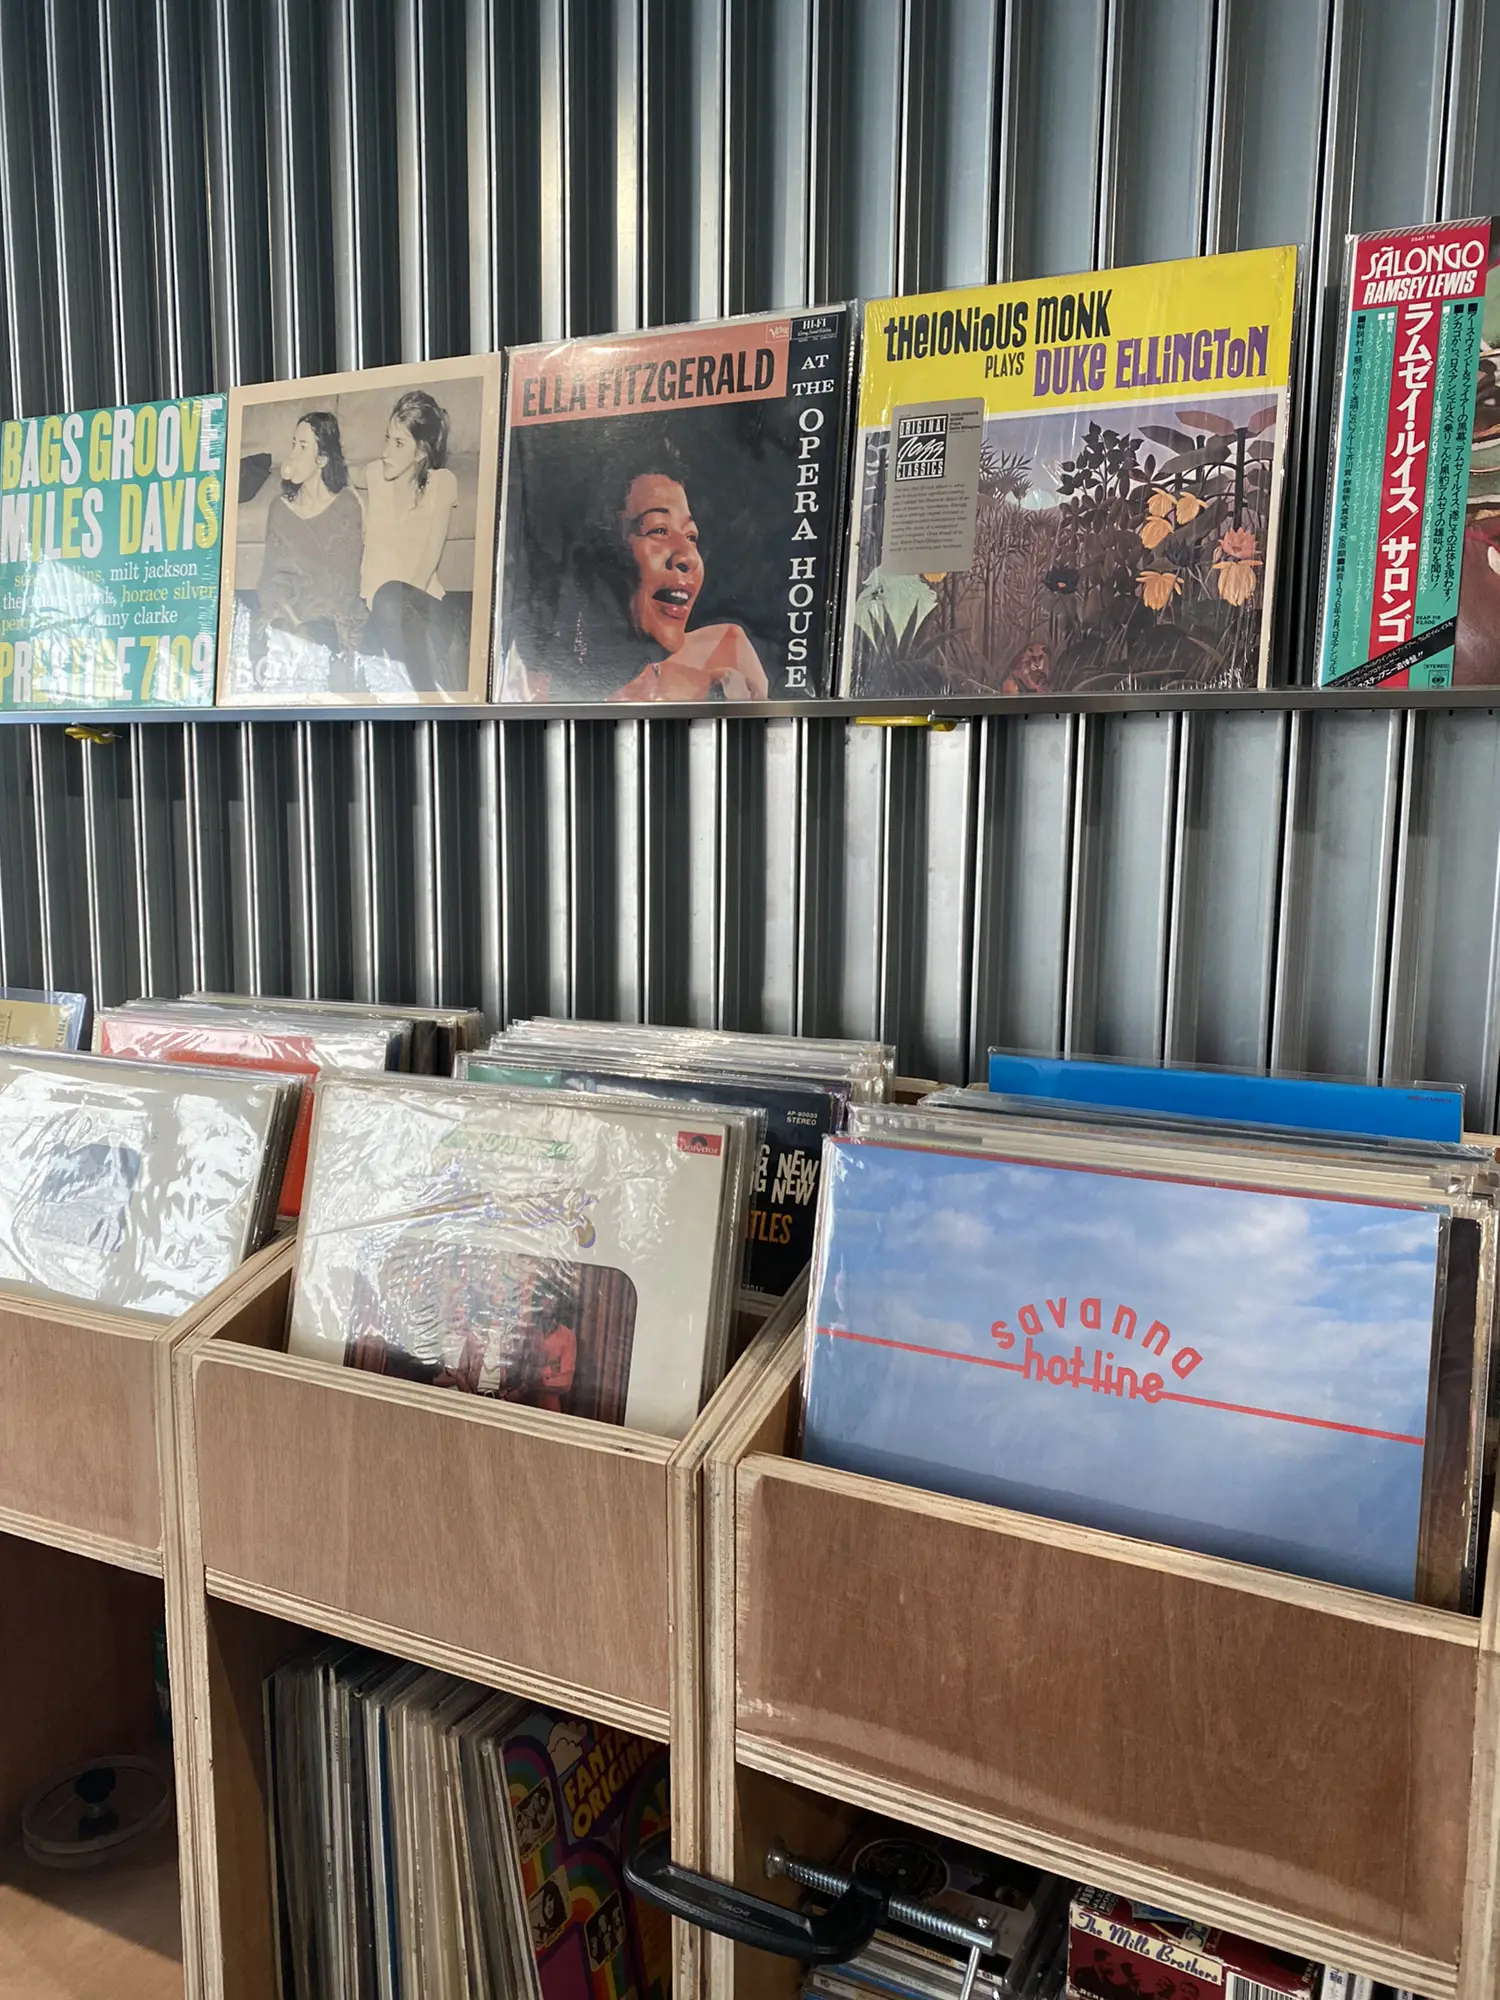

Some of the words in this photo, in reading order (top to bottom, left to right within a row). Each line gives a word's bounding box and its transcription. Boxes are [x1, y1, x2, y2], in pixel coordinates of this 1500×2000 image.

[1363, 275, 1429, 305] RAMSEY
[1426, 270, 1478, 298] LEWIS
[801, 354, 829, 371] AT
[984, 352, 1025, 379] PLAYS
[522, 373, 587, 417] ELLA
[597, 348, 775, 408] FITZGERALD
[792, 379, 834, 397] THE
[2, 413, 84, 489] BAGS
[88, 398, 223, 482] GROOVE
[791, 407, 826, 542] OPERA
[896, 461, 944, 478] CLASSICS
[0, 488, 103, 564] MILES
[119, 476, 221, 555] DAVIS
[109, 564, 139, 582] milt
[143, 559, 198, 583] jackson
[121, 583, 168, 604] horace
[133, 605, 178, 625] clarke
[784, 557, 817, 688] HOUSE
[140, 632, 214, 706] 7109
[786, 1116, 817, 1126] STEREO
[777, 1149, 820, 1186] NEW
[771, 1178, 815, 1206] NEW
[749, 1210, 793, 1244] TLES
[991, 1297, 1204, 1380] savanna
[1023, 1337, 1164, 1404] hotline
[1075, 1912, 1103, 1937] The
[1109, 1924, 1151, 1957] Mills
[1156, 1945, 1219, 1984] Brothers
